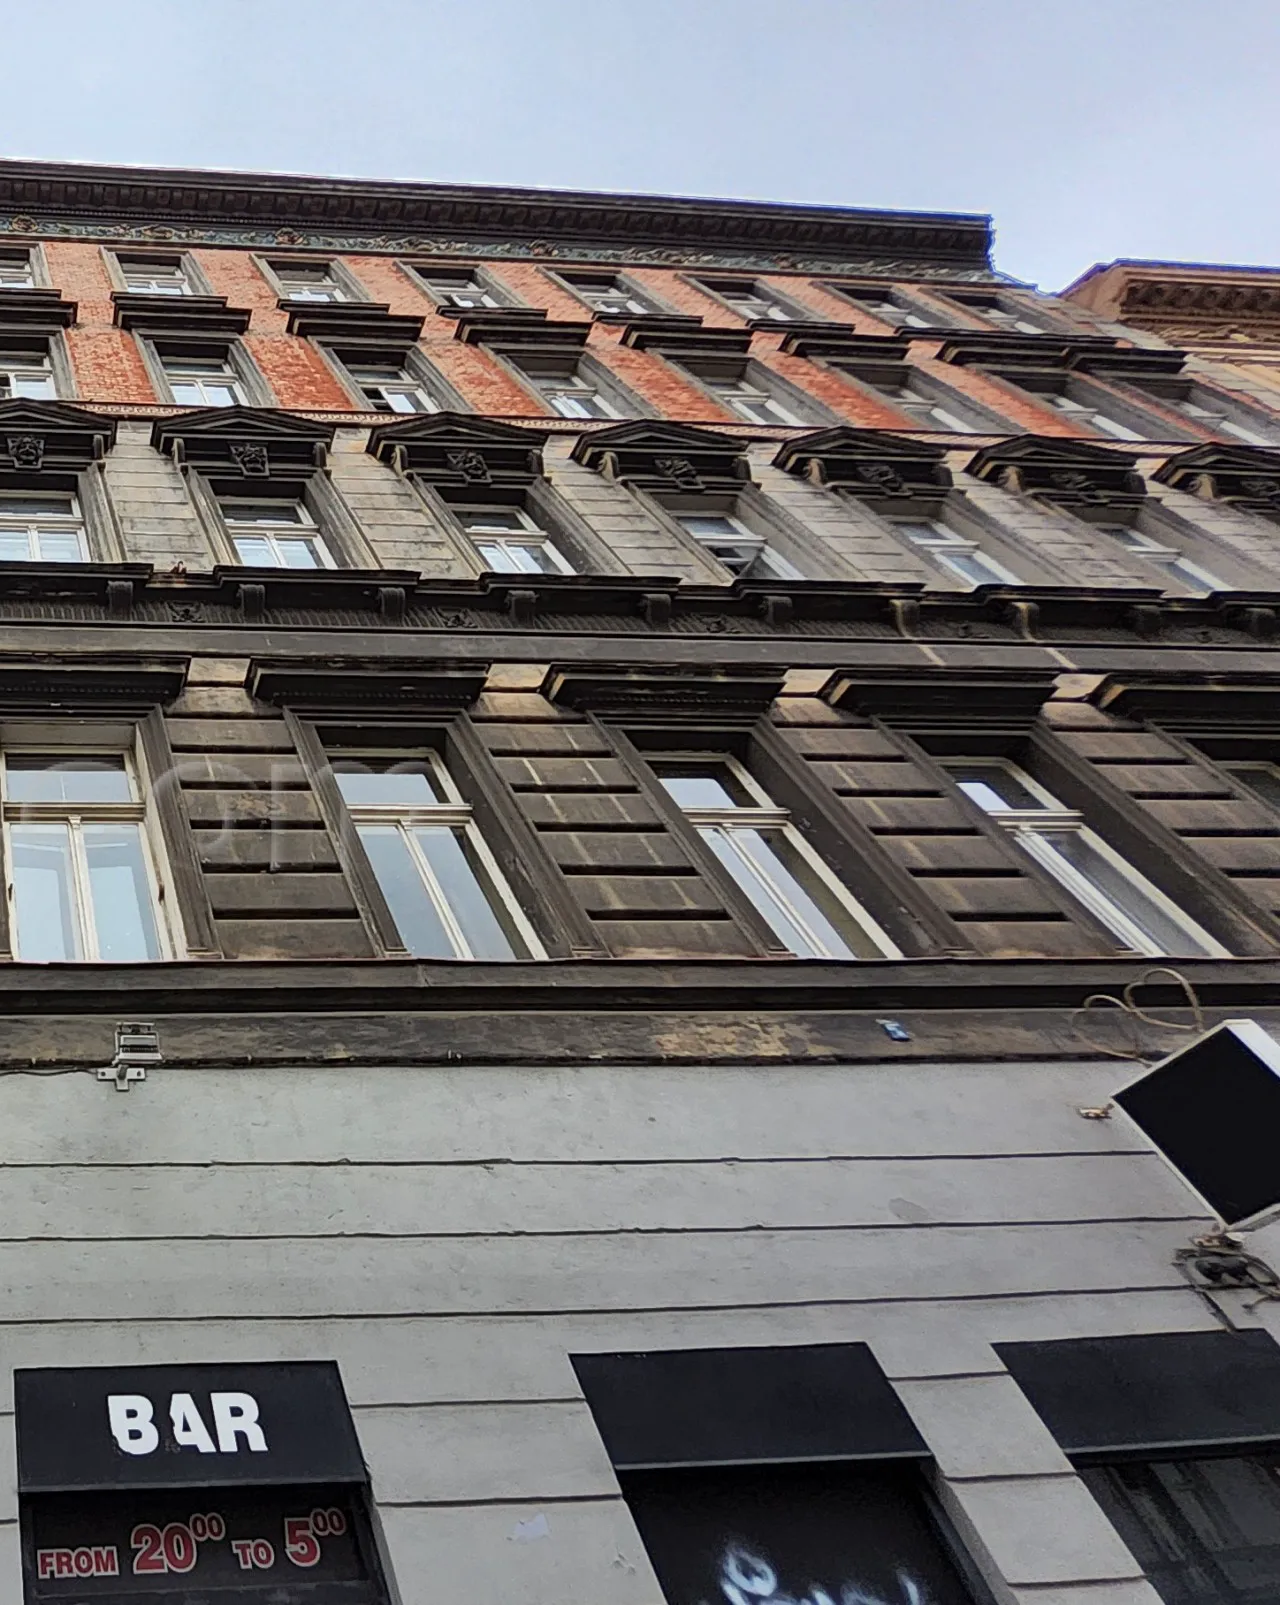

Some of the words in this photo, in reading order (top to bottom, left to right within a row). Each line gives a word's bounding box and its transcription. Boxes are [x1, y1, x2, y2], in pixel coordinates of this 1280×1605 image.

[107, 1392, 268, 1455] BAR
[37, 1546, 119, 1579] FROM
[231, 1538, 275, 1570] TO
